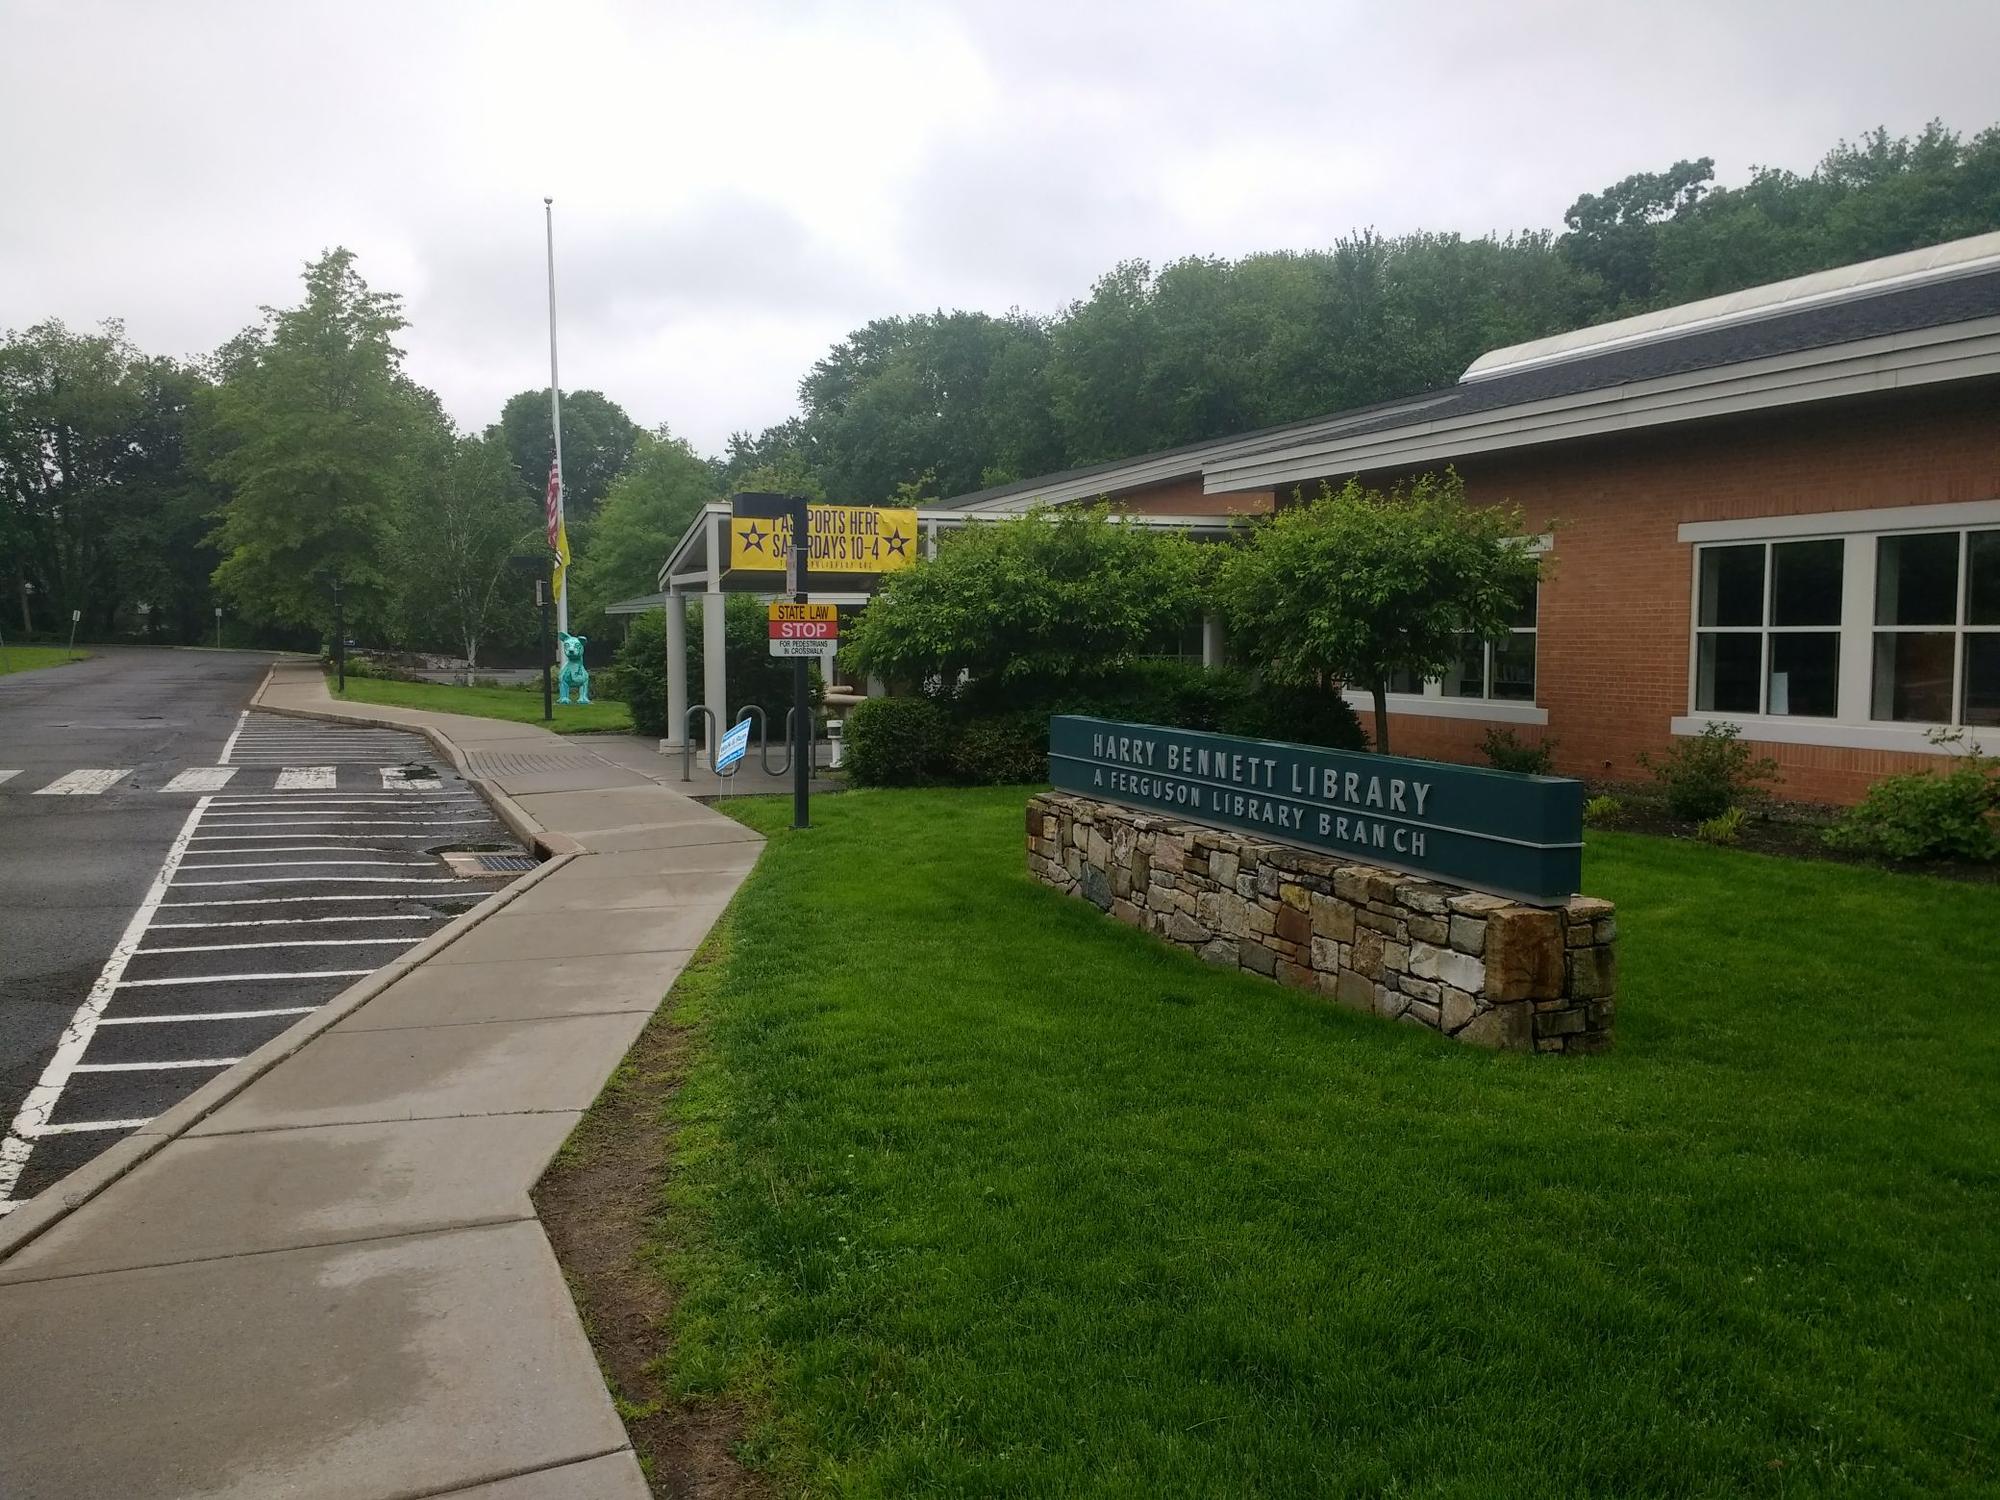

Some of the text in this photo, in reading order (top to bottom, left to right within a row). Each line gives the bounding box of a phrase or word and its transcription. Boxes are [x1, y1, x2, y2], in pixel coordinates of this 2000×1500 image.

[850, 511, 880, 536] HERE
[773, 534, 880, 561] SARDAYS 10-4
[778, 605, 829, 620] STATE LAW
[781, 622, 827, 637] STOP
[780, 640, 828, 648] FOR PEDESTRIANS
[784, 647, 824, 655] IN CROSSWALK
[1093, 733, 1432, 816] HARRY BENNETT LIBRARY
[1093, 768, 1425, 857] A FERGUSON LIBRARY BRANCH
